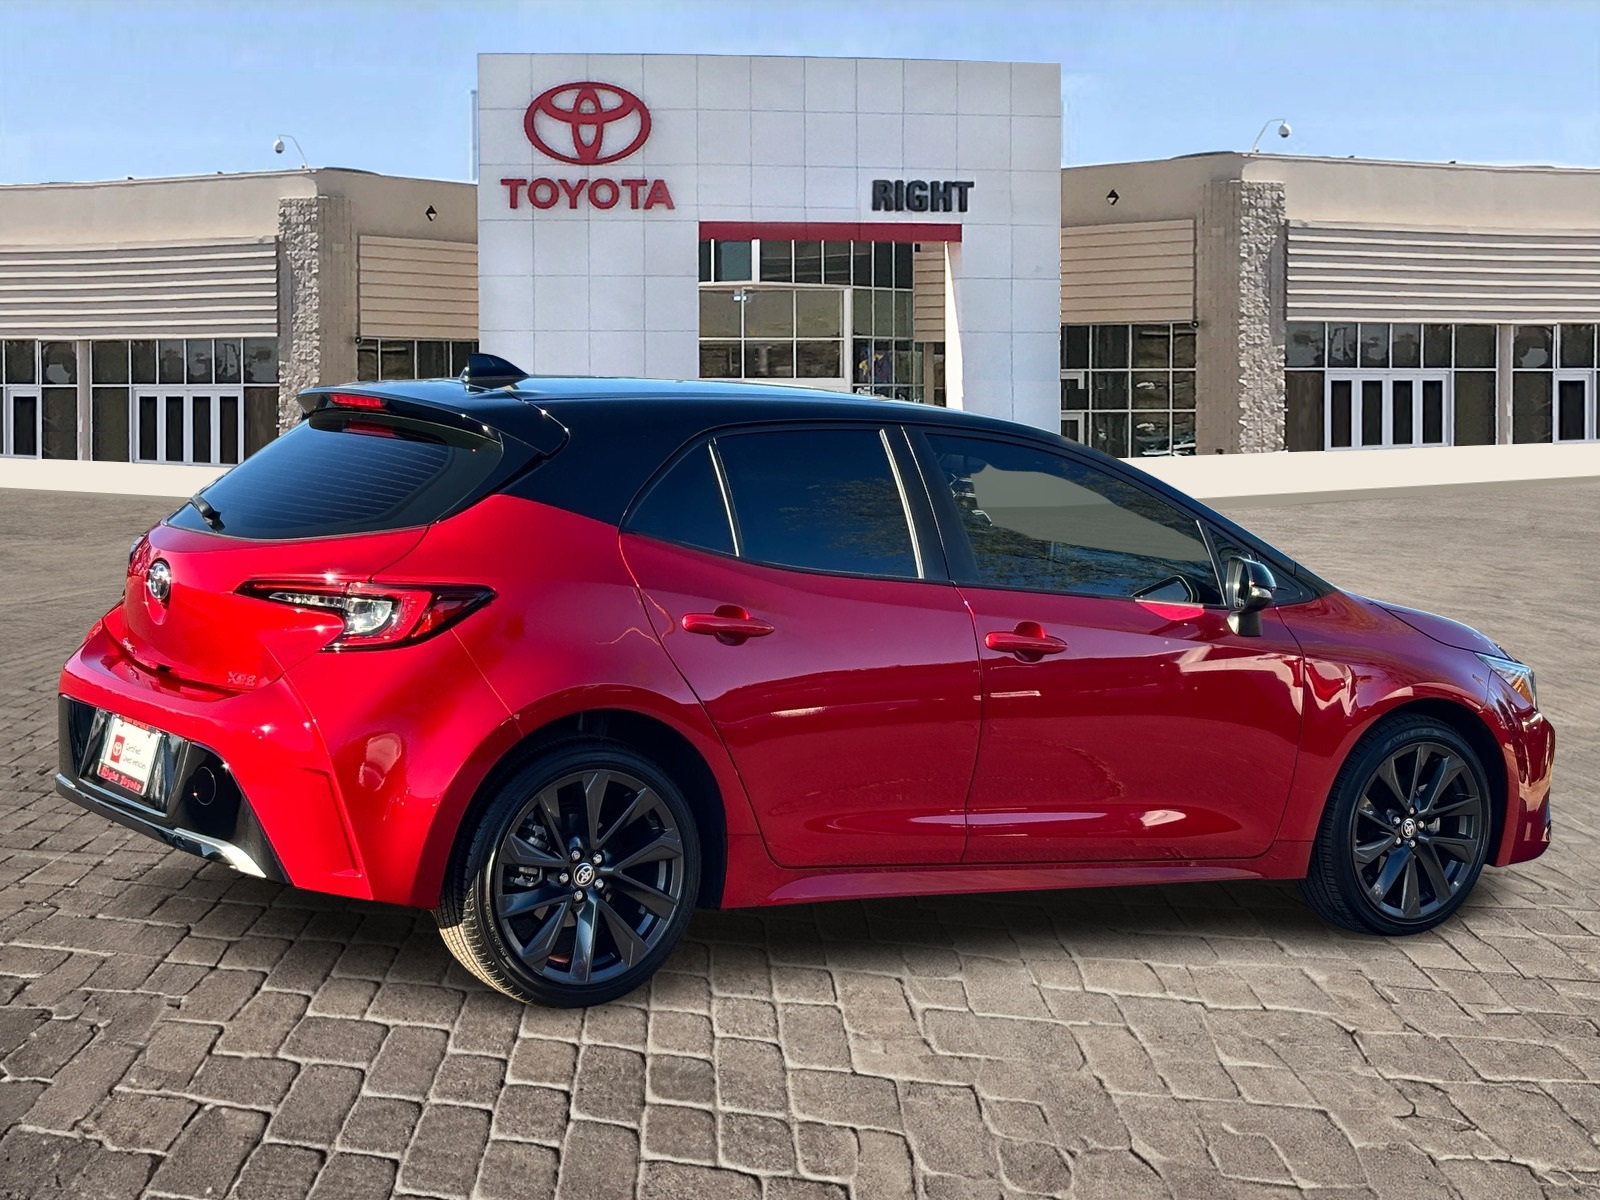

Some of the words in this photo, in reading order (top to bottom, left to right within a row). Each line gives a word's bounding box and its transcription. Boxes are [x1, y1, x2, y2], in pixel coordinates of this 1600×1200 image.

[500, 178, 675, 210] TOYOTA
[872, 180, 975, 212] RIGHT
[119, 775, 142, 792] Toyota
